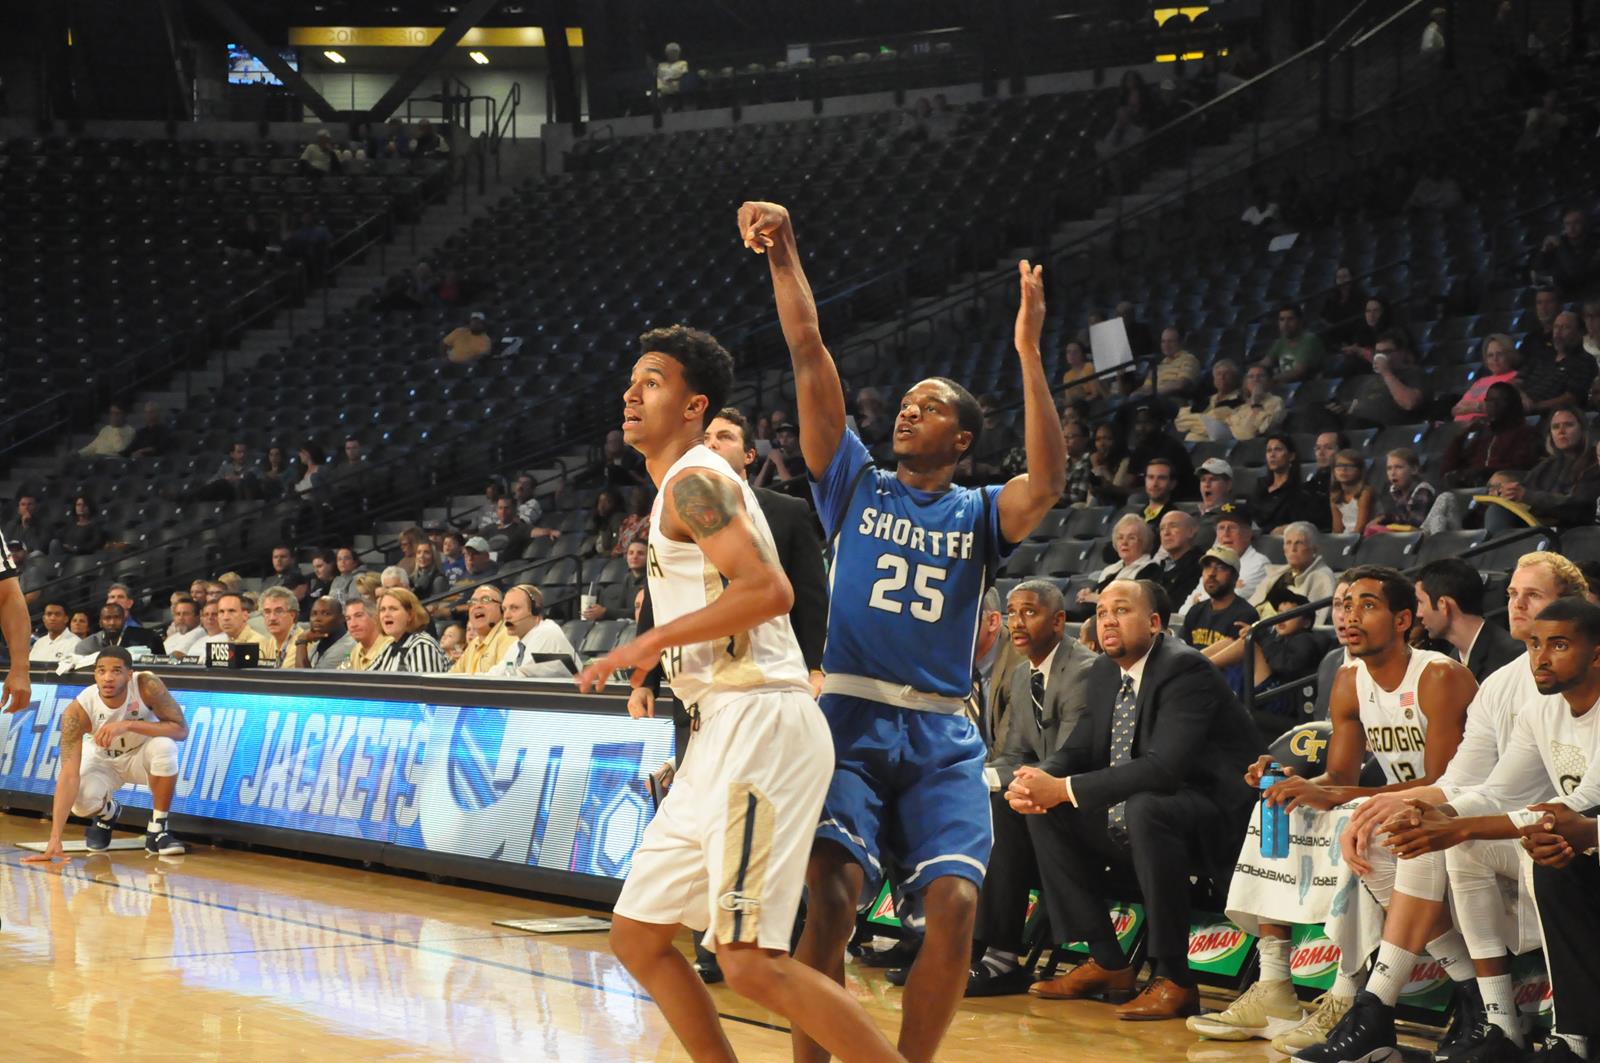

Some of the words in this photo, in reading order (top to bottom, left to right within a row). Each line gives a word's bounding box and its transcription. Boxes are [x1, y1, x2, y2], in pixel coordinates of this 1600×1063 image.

[858, 506, 975, 560] SHORTER
[868, 553, 947, 623] 25
[211, 644, 230, 660] POSS
[238, 710, 430, 827] JACKETS
